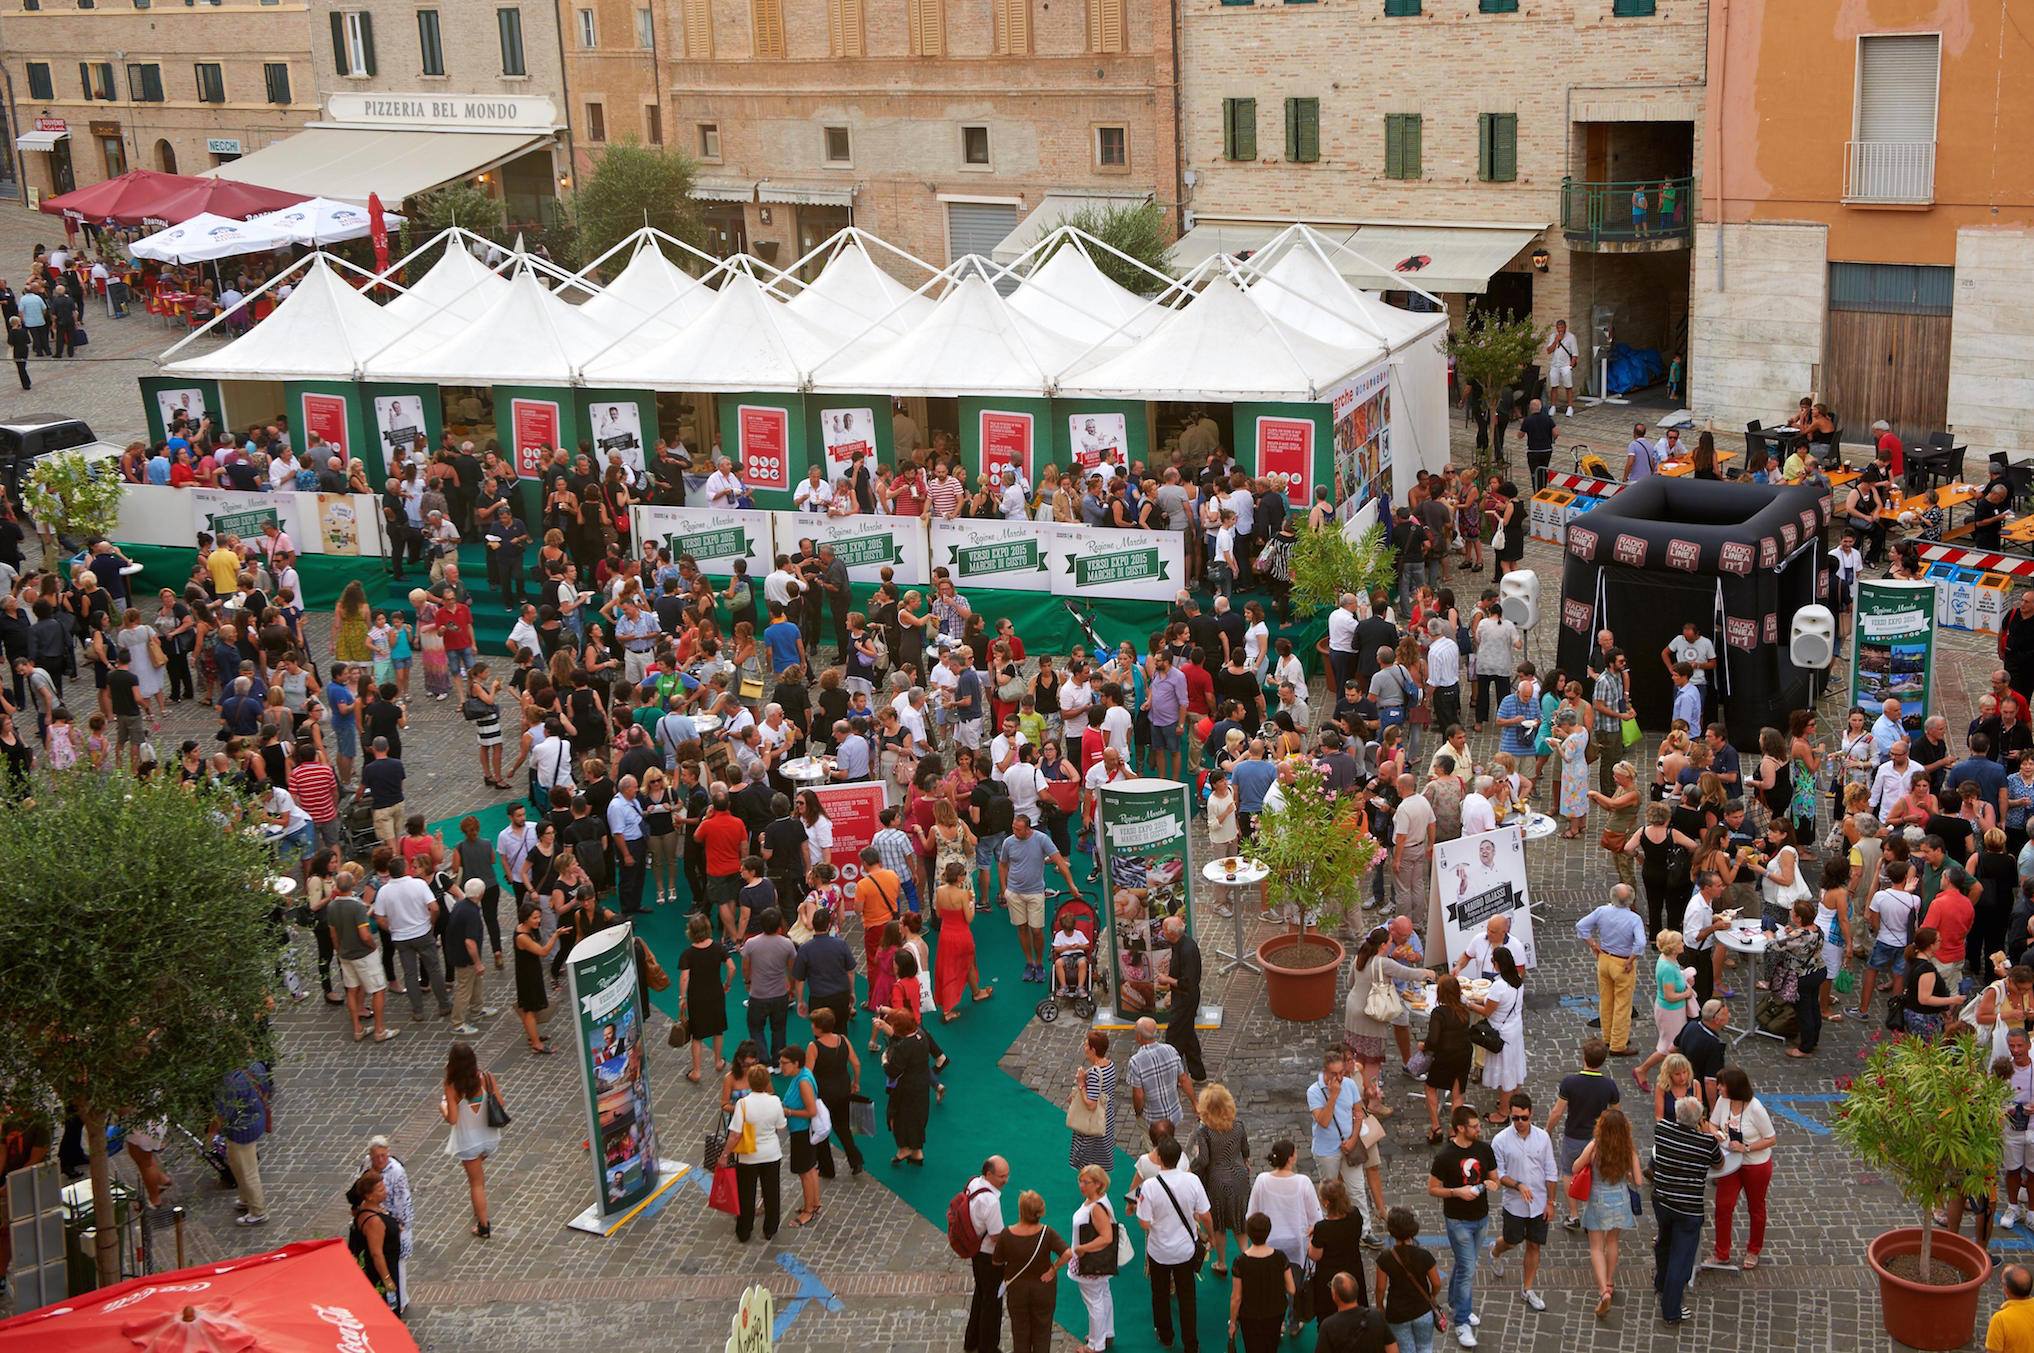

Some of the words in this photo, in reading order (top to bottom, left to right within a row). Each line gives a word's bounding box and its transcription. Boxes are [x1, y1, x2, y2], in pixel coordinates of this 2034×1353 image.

[364, 101, 424, 117] PIZZERIA
[432, 102, 458, 118] BEL
[464, 103, 518, 119] MONDO
[209, 140, 238, 152] NECCHI
[1333, 388, 1353, 412] arche
[681, 537, 702, 549] VERSO
[703, 534, 719, 546] EXPO
[720, 531, 736, 543] 2015
[968, 531, 995, 546] Regione
[996, 526, 1026, 541] Marche
[1570, 527, 1595, 542] RADIO
[708, 544, 716, 555] DI
[716, 541, 737, 554] GUSTO
[849, 540, 866, 552] EXPO
[867, 538, 884, 550] 2015
[1086, 539, 1114, 554] Regione
[1115, 533, 1148, 551] Marche
[1569, 534, 1593, 549] LINEA
[1619, 536, 1644, 550] RADIO
[1671, 542, 1697, 553] RADIO
[855, 552, 862, 562] DI
[863, 549, 884, 562] GUSTO
[968, 549, 990, 562] VERSO
[991, 547, 1009, 559] EXPO
[1010, 544, 1027, 557] 2015
[1571, 544, 1588, 557] n°1
[1617, 543, 1643, 556] LINEA
[1669, 549, 1696, 561] LINEA
[1724, 543, 1752, 556] RADIO
[1086, 557, 1109, 571] VERSO
[1110, 555, 1129, 568] EXPO
[1130, 552, 1148, 566] 2015
[1620, 553, 1637, 563] n°1
[1672, 557, 1691, 569] n°1
[1723, 550, 1750, 563] LINEA
[969, 559, 997, 573] MARCHE
[997, 558, 1005, 569] DI
[1005, 555, 1028, 568] GUSTO
[1725, 560, 1744, 571] n°1
[1086, 568, 1116, 582] MARCHE
[1116, 566, 1124, 578] DI
[1125, 564, 1148, 577] GUSTO
[1564, 606, 1588, 620] LINEA
[1565, 600, 1589, 614] RADIO
[1565, 615, 1582, 628] n°1
[1728, 618, 1755, 630] RADIO
[1727, 625, 1754, 637] LINEA
[1730, 636, 1748, 646] n°1
[1138, 823, 1152, 833] EXPO
